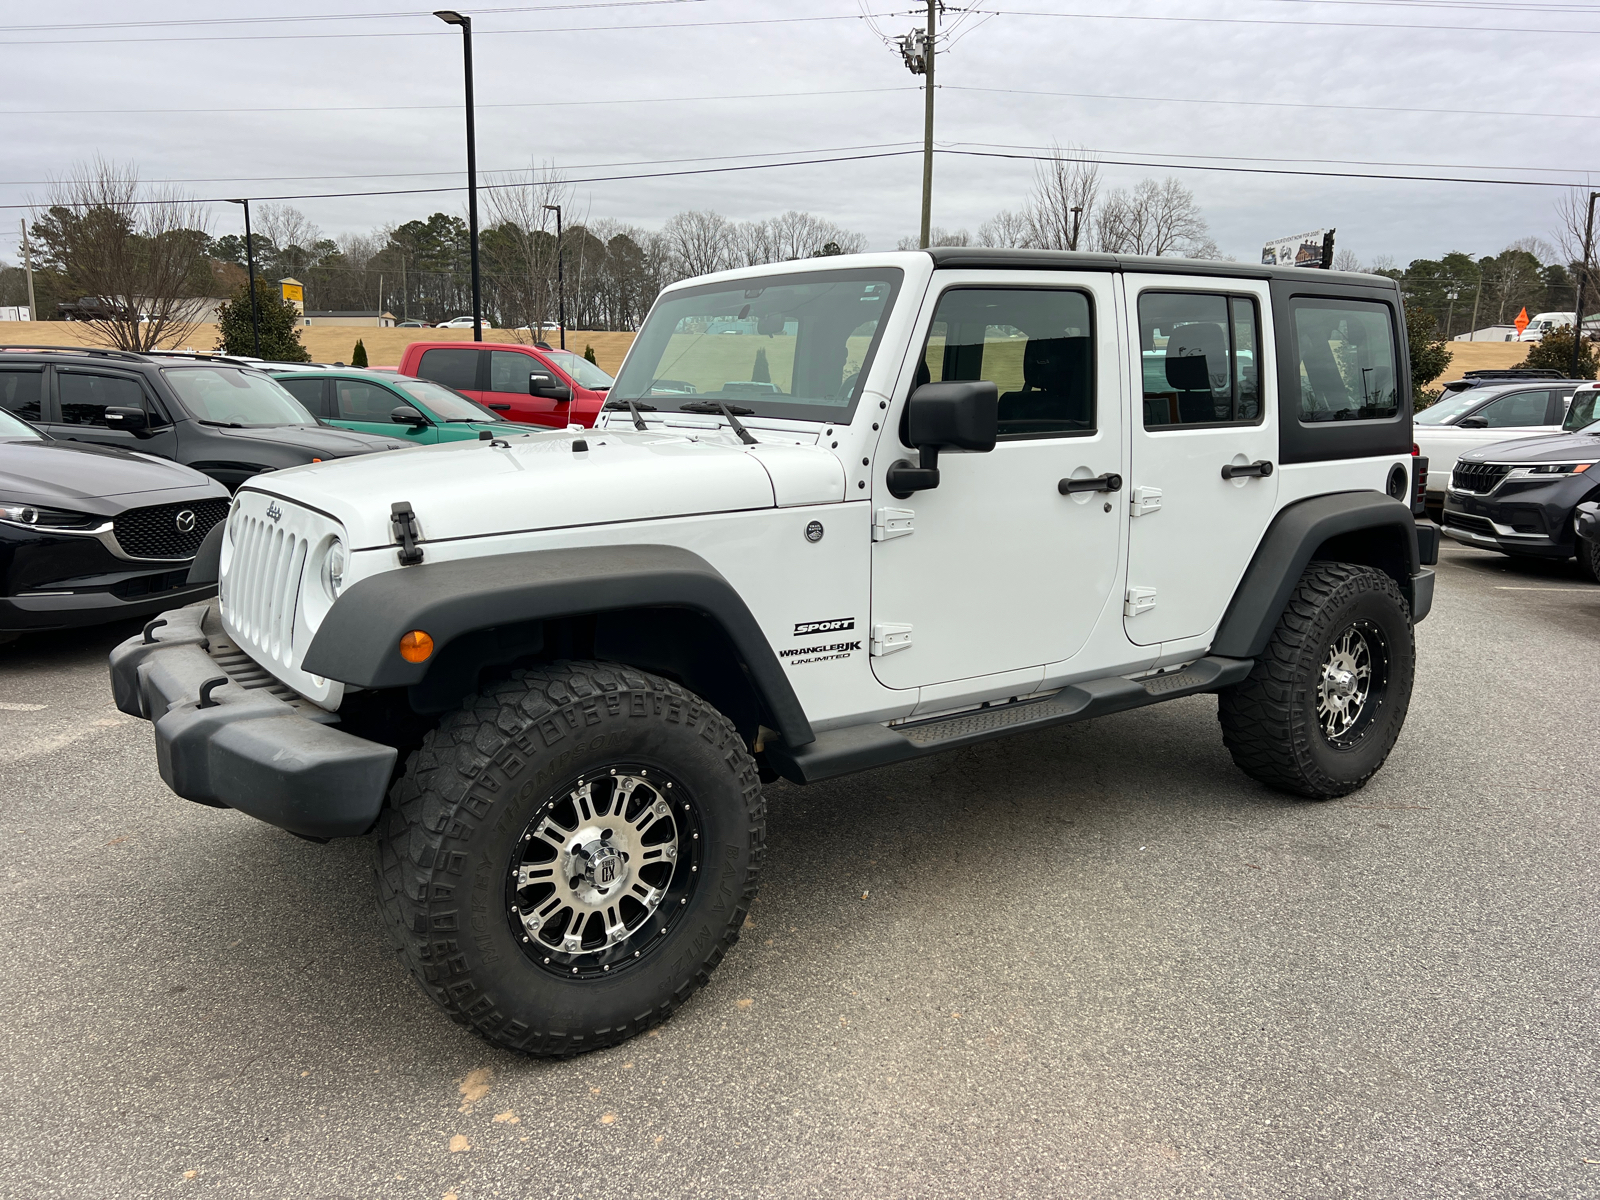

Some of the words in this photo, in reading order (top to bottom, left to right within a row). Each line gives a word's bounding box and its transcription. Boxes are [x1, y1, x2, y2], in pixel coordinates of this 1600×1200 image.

[794, 618, 855, 635] SPORT
[791, 653, 851, 666] UNLIMITED
[470, 851, 500, 967] MICKEY
[492, 729, 628, 837] THOMPSON
[602, 864, 615, 882] XD
[711, 843, 740, 914] BAJA
[670, 923, 714, 979] MTZ
